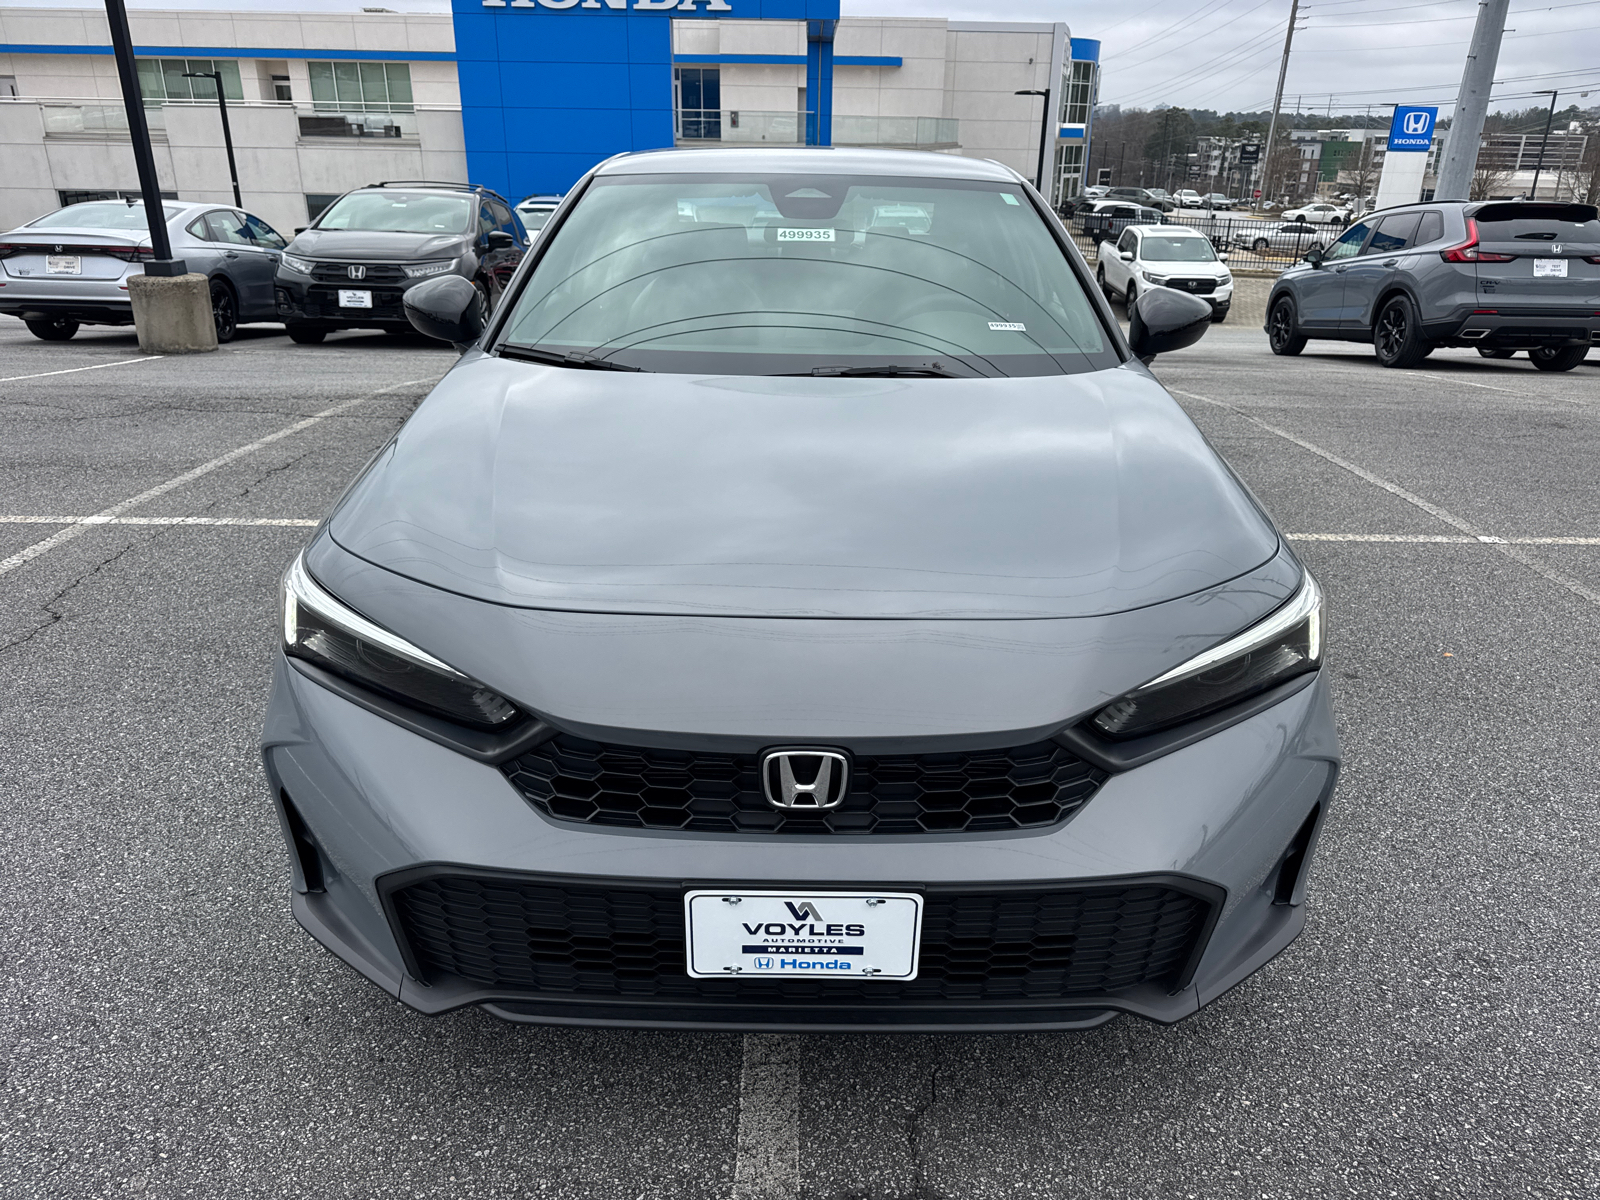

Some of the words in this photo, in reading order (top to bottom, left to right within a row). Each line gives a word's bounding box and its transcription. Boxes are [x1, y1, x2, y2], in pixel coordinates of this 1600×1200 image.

[779, 230, 831, 239] 499935
[742, 922, 865, 937] VOYLES
[767, 946, 838, 954] MARIETTA
[780, 958, 852, 970] Honda
